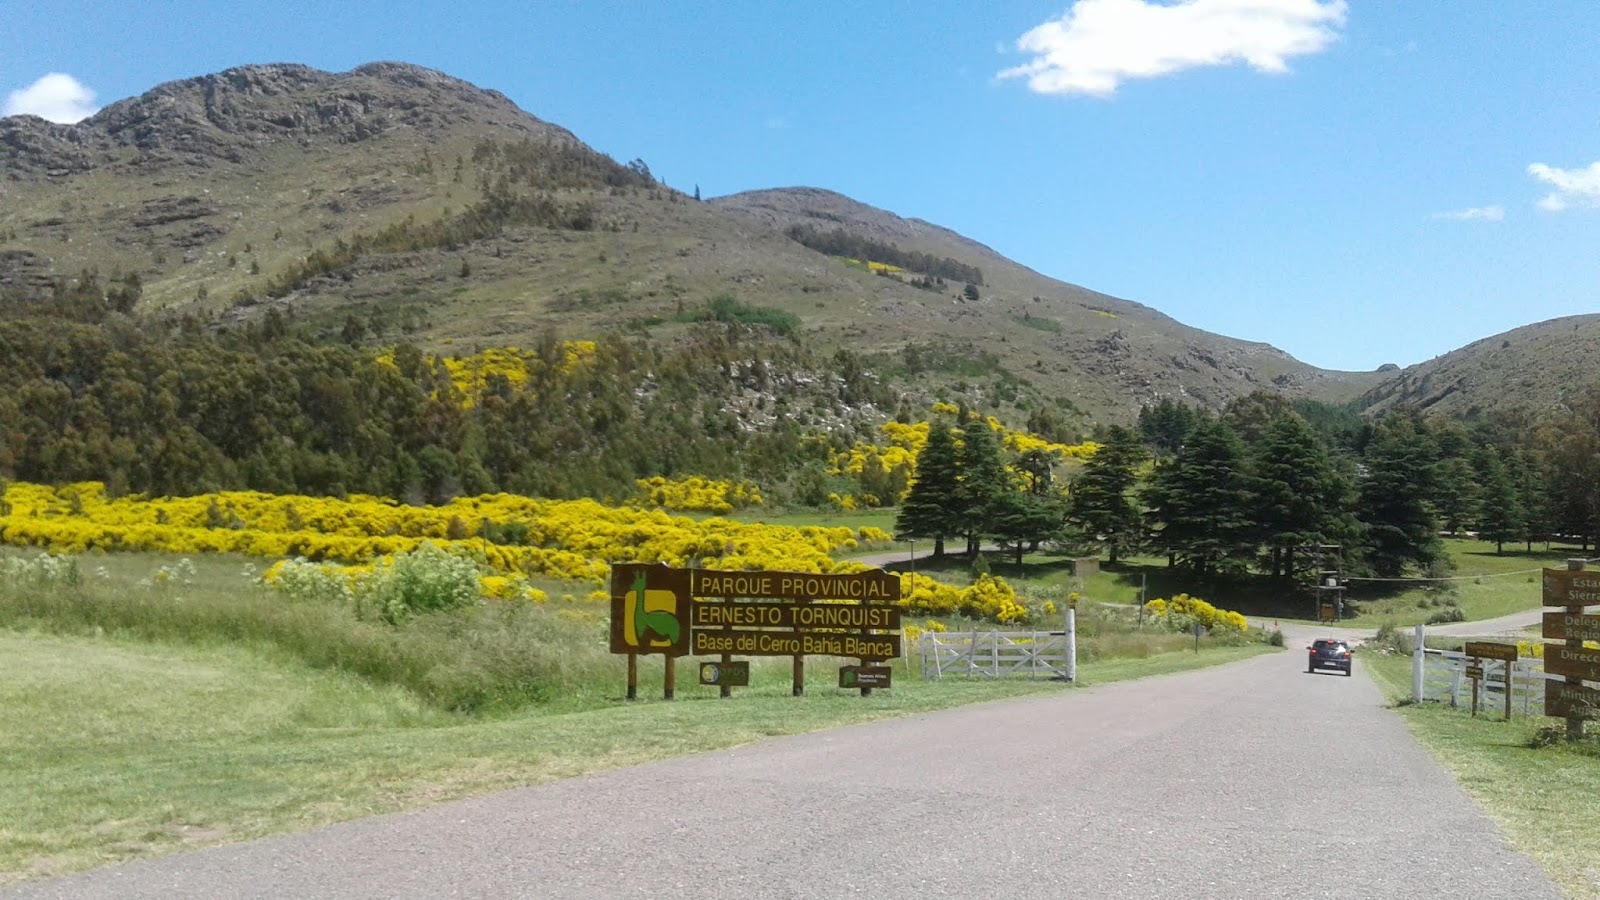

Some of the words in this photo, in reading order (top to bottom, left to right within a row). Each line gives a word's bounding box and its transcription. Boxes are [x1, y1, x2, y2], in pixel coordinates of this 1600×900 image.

[701, 577, 772, 596] PARQUE
[781, 578, 891, 597] PROVINCIAL
[698, 607, 782, 625] ERNESTO
[790, 607, 893, 626] TORNQUIST
[696, 633, 732, 650] Base
[736, 634, 757, 651] del
[760, 635, 800, 652] Cerro
[803, 636, 842, 654] Bahía
[845, 639, 894, 657] Blanca
